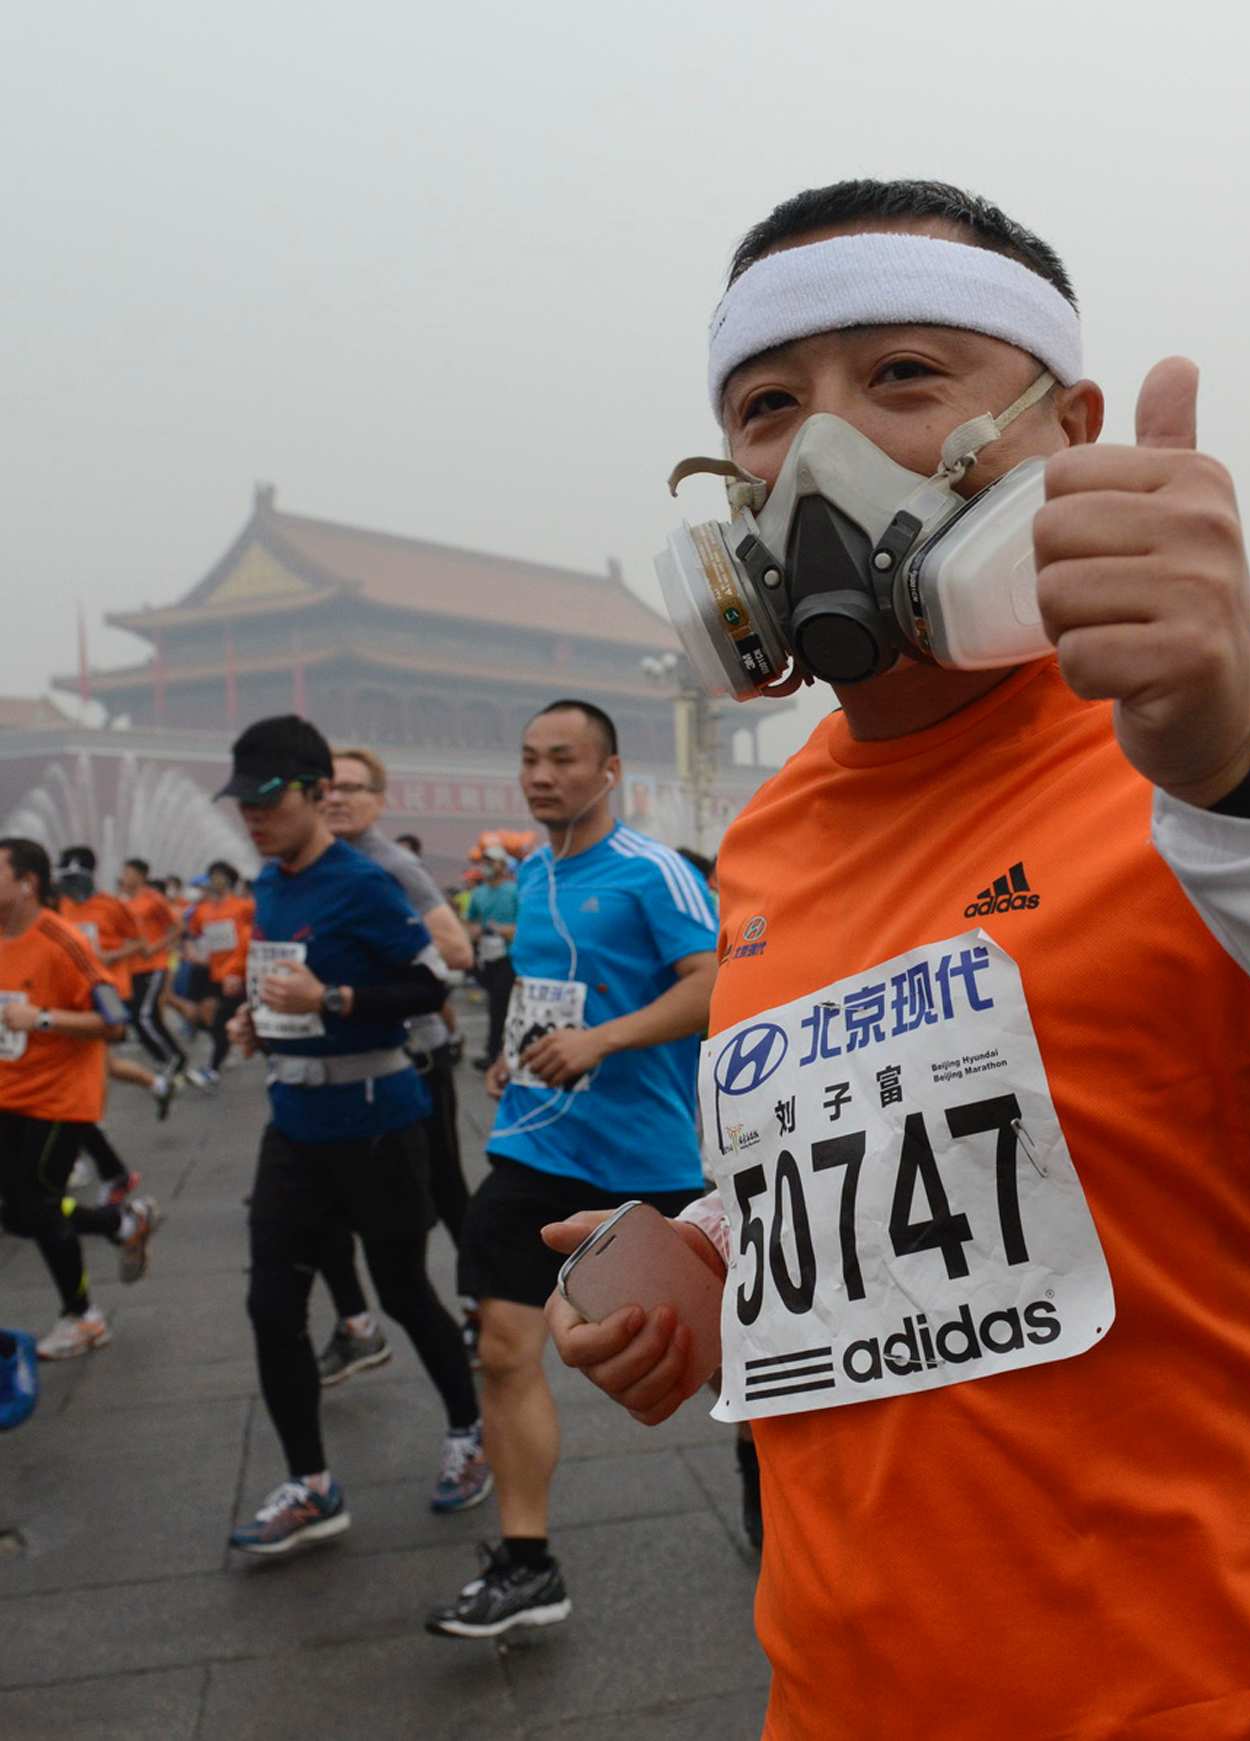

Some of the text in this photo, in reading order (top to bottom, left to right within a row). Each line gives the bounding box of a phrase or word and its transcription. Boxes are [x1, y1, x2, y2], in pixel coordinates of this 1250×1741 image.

[963, 893, 1040, 918] adidas
[800, 946, 994, 1066] 北京现代
[931, 1048, 999, 1071] Beijing Hyundai
[933, 1059, 1008, 1082] Beijing Marathon
[733, 1092, 1030, 1326] 50747
[842, 1300, 1062, 1383] adidas
